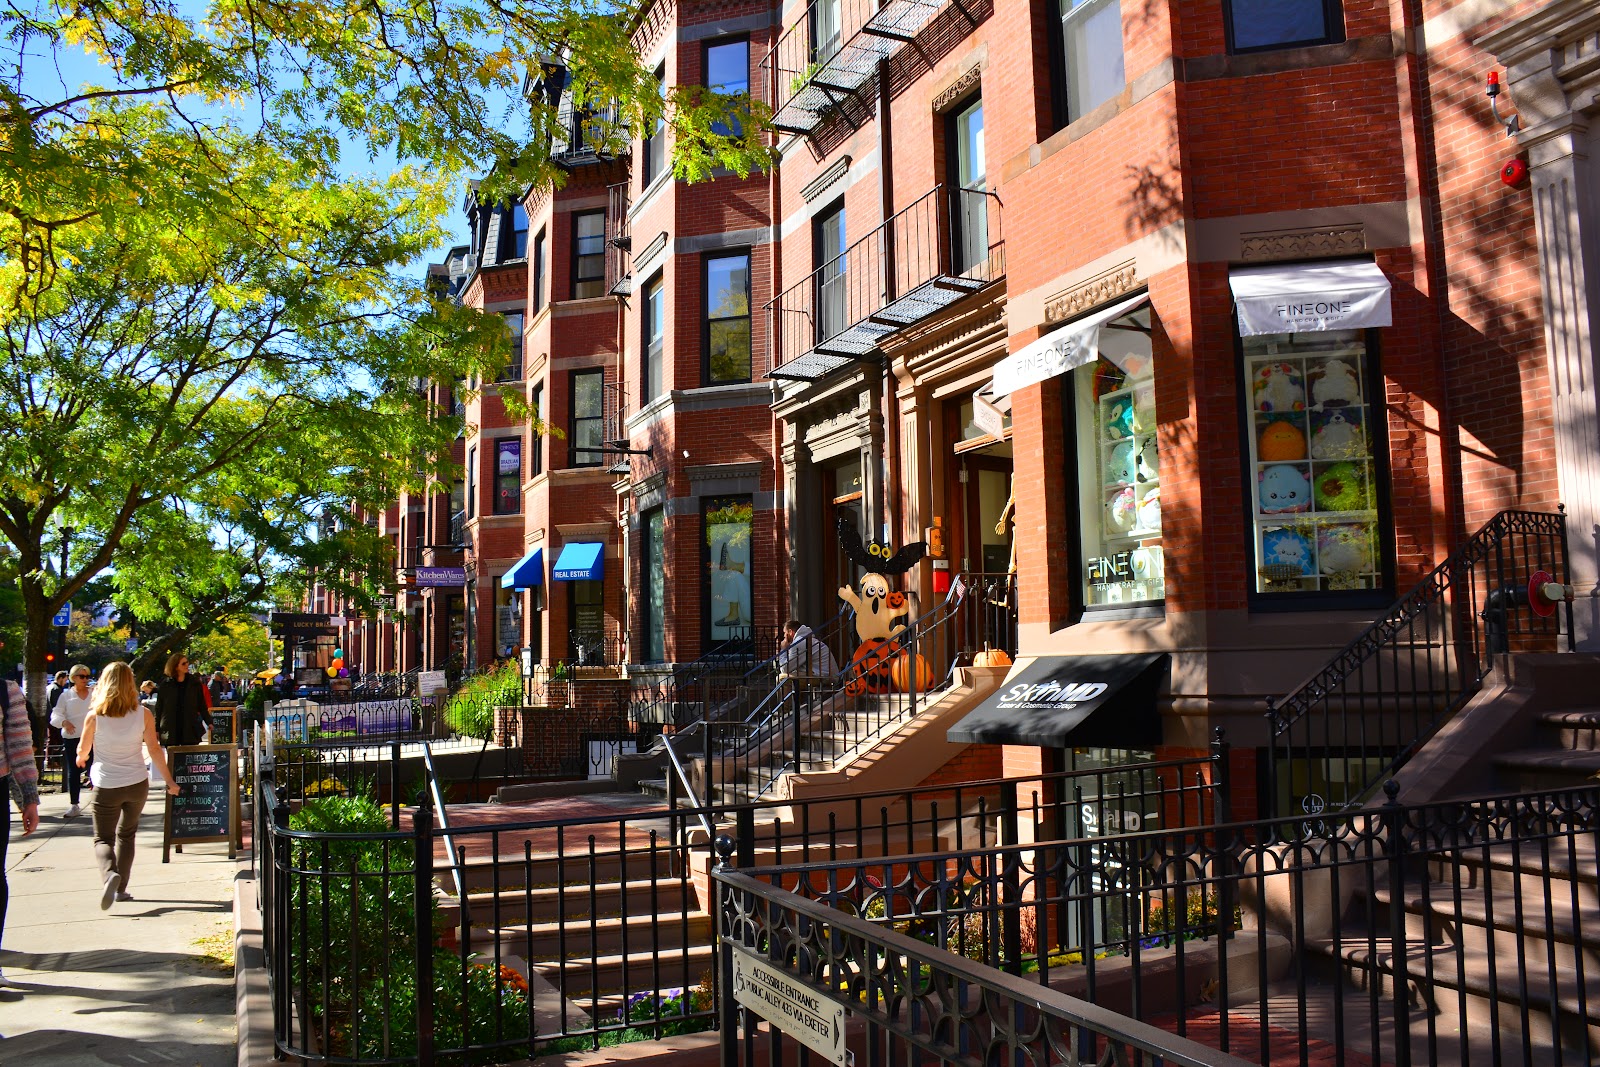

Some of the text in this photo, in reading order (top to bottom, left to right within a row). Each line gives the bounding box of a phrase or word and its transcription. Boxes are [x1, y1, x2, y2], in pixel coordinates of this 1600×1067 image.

[1277, 301, 1351, 316] FINEONE
[1017, 340, 1071, 376] FINEONE
[416, 570, 465, 579] KitchenWares
[1053, 702, 1077, 711] Group
[187, 764, 216, 773] WELCOME
[752, 966, 820, 1014] ACCESSIBLE ENTRANCE
[745, 980, 829, 1038] PUBLIC ALLEY 433 VIA EXETER
